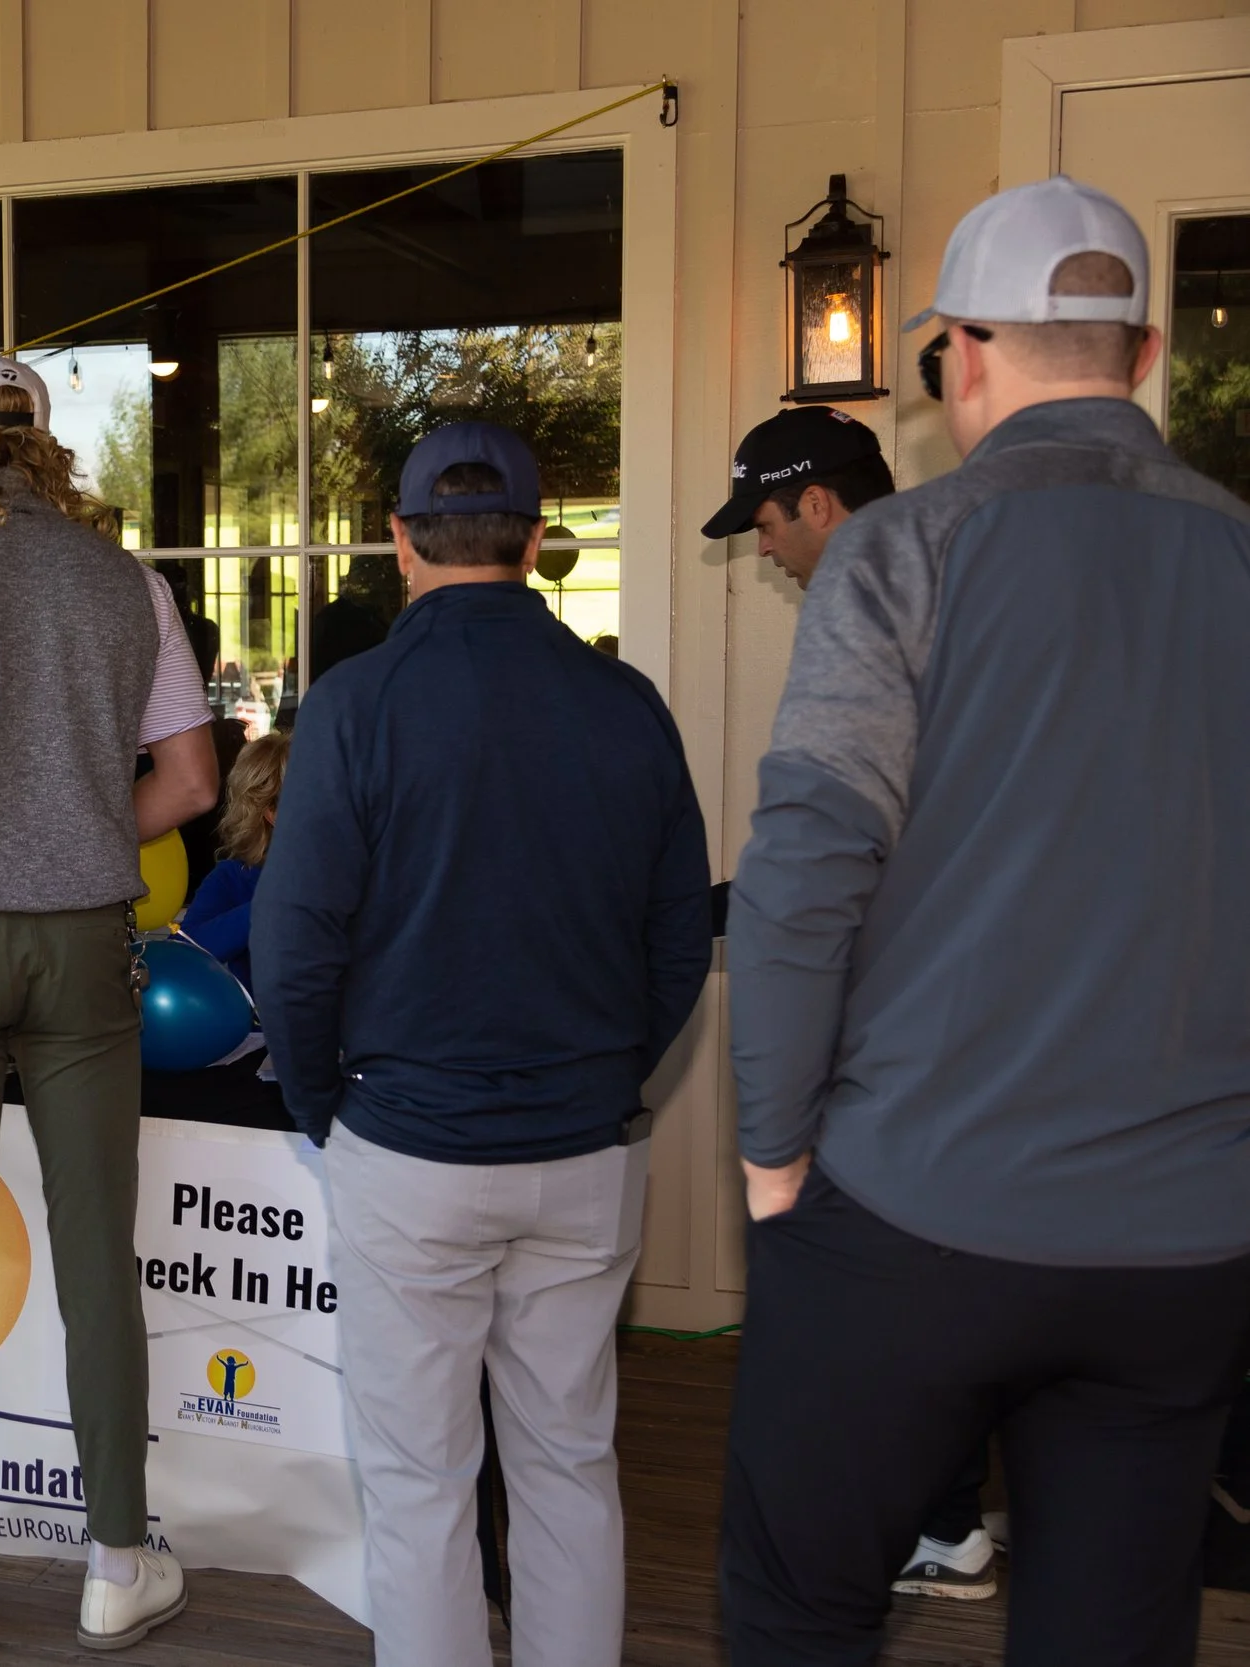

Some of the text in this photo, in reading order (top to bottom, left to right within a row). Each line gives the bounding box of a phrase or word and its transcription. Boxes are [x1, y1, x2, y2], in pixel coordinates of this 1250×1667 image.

[759, 467, 792, 484] PRO
[792, 460, 812, 473] V1
[172, 1182, 305, 1241] Please
[136, 1252, 339, 1314] eck In He
[183, 1397, 278, 1423] The EVAN Foundation
